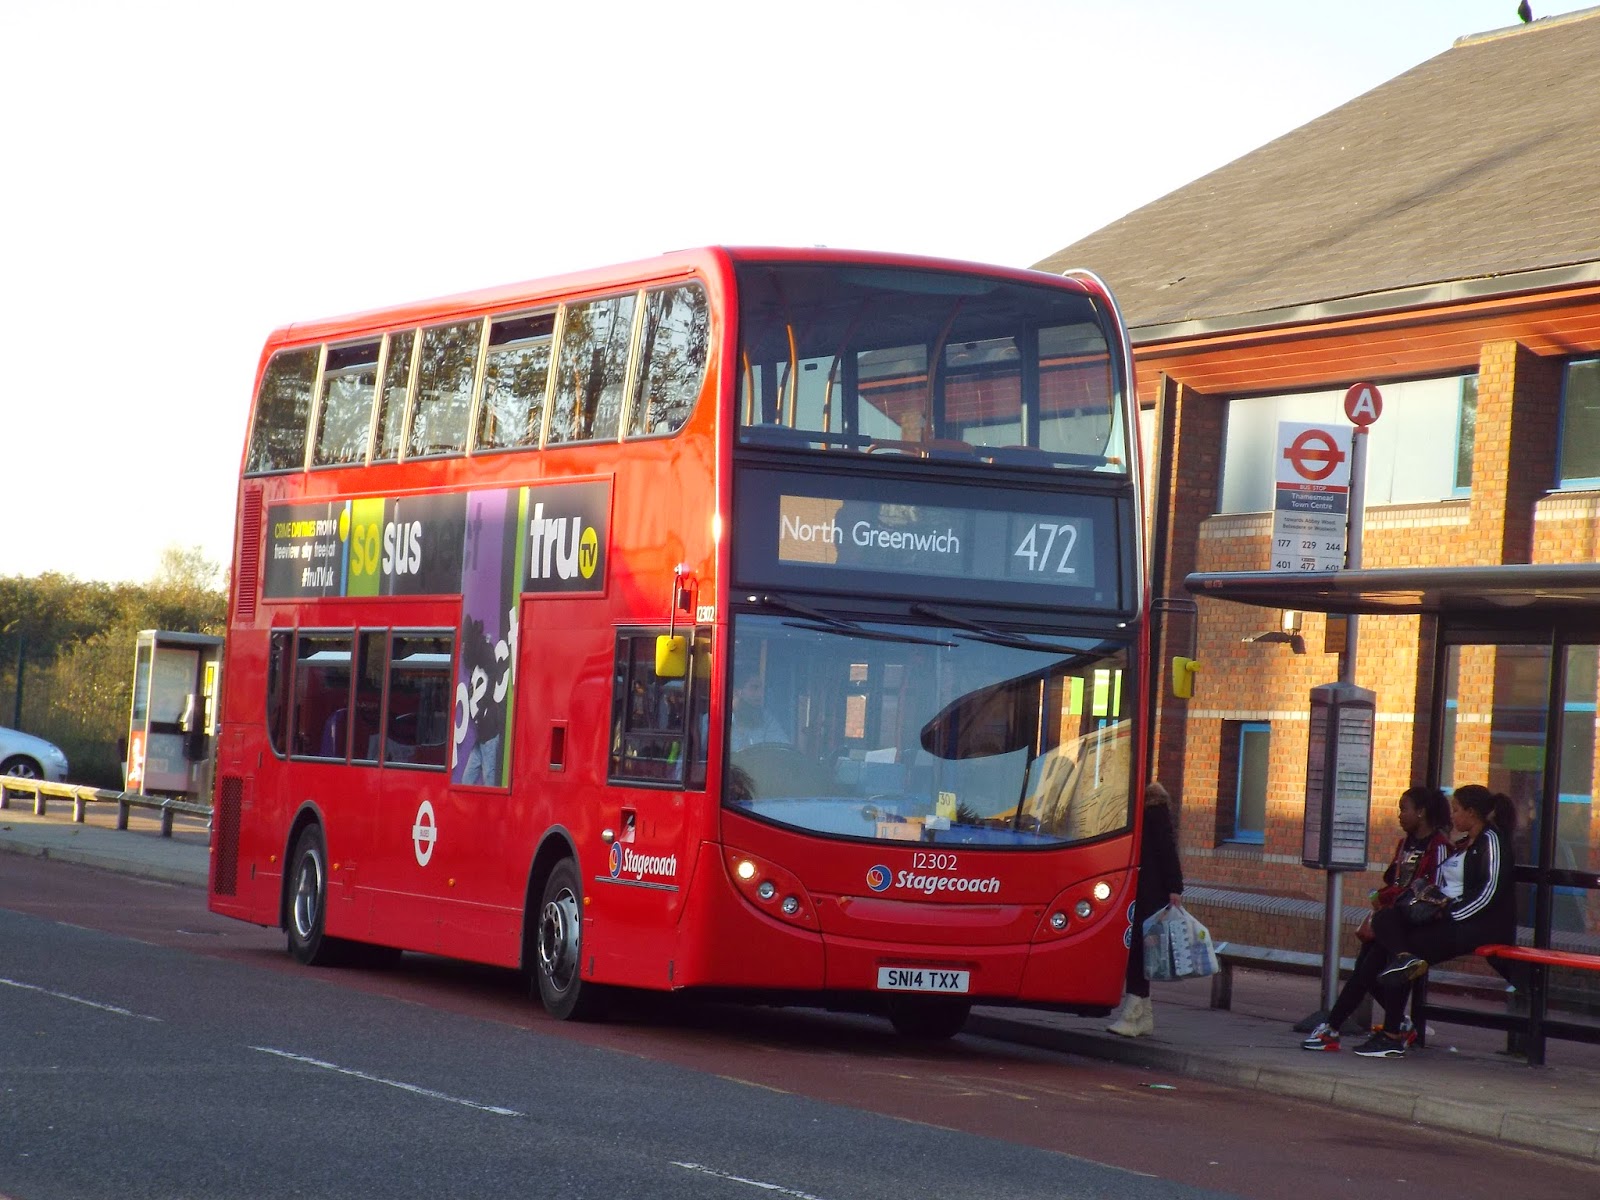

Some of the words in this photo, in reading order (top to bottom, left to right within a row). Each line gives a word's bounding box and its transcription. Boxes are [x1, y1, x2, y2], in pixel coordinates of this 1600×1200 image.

[1352, 388, 1377, 419] A
[1291, 492, 1334, 501] Thamesmead
[1291, 500, 1309, 508] Town
[1310, 501, 1333, 510] Centre
[351, 525, 379, 576] so
[382, 519, 422, 575] sus
[530, 502, 581, 580] tru
[580, 544, 595, 567] TV
[780, 514, 843, 544] North
[852, 520, 960, 554] Greenwich
[1014, 523, 1078, 574] 472
[1278, 539, 1291, 548] 177
[1302, 540, 1317, 549] 229
[1325, 542, 1341, 551] 244
[274, 543, 300, 560] freeview
[1276, 560, 1291, 569] 401
[1300, 562, 1315, 571] 472
[622, 847, 677, 881] Stagecoach
[912, 852, 958, 871] 12302
[895, 870, 1000, 895] Stagecoach
[888, 970, 924, 987] SN14
[929, 972, 960, 989] TXX
